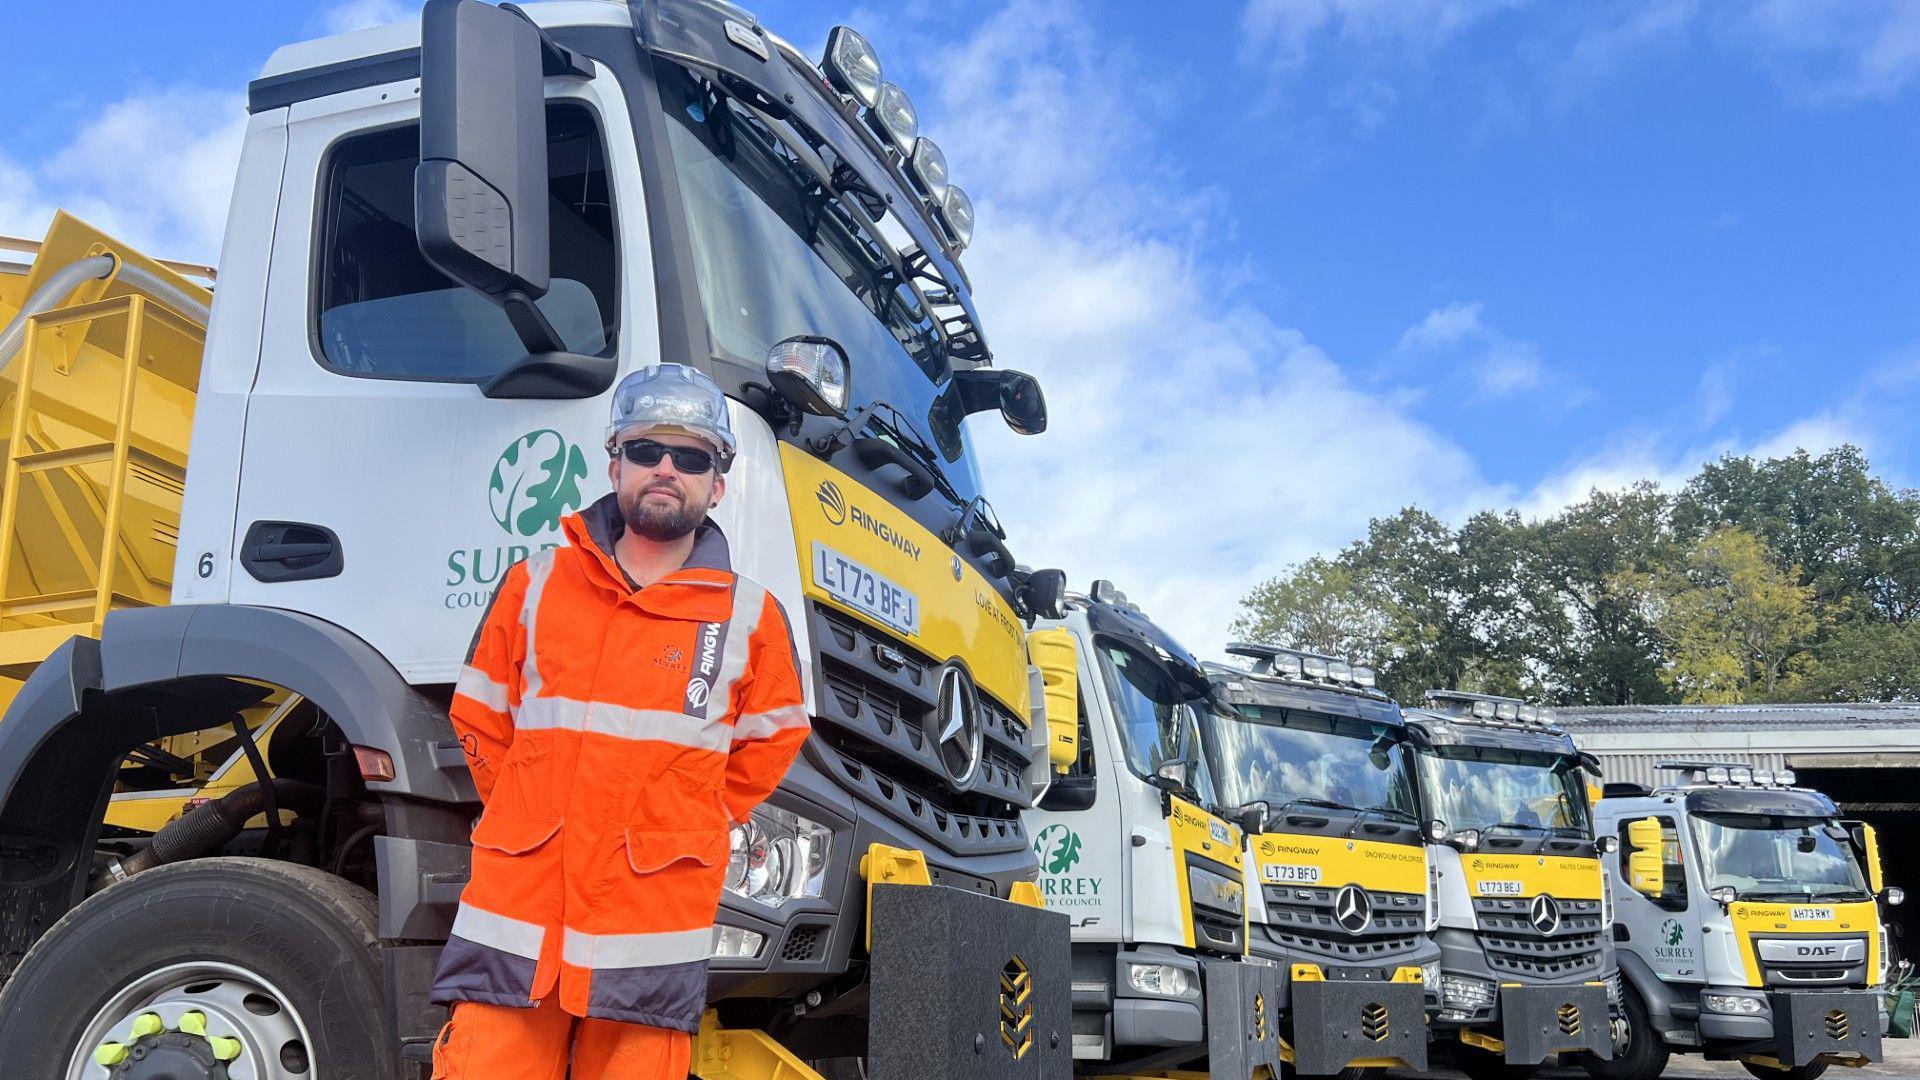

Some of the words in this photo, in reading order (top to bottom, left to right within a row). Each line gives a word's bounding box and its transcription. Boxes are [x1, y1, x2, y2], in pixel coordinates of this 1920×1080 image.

[851, 505, 920, 561] RINGWAY
[199, 552, 213, 578] 6
[822, 549, 875, 606] LT73
[880, 580, 913, 627] BFJ
[700, 622, 721, 676] RINGW
[1278, 846, 1319, 855] RINGWAY
[1266, 866, 1294, 878] LT73
[1298, 868, 1317, 880] BFO
[1480, 882, 1502, 892] LT73
[1059, 898, 1100, 906] COUNCIL
[1794, 909, 1814, 918] AH73
[1655, 947, 1694, 958] SURREY
[1797, 947, 1836, 956] DAF
